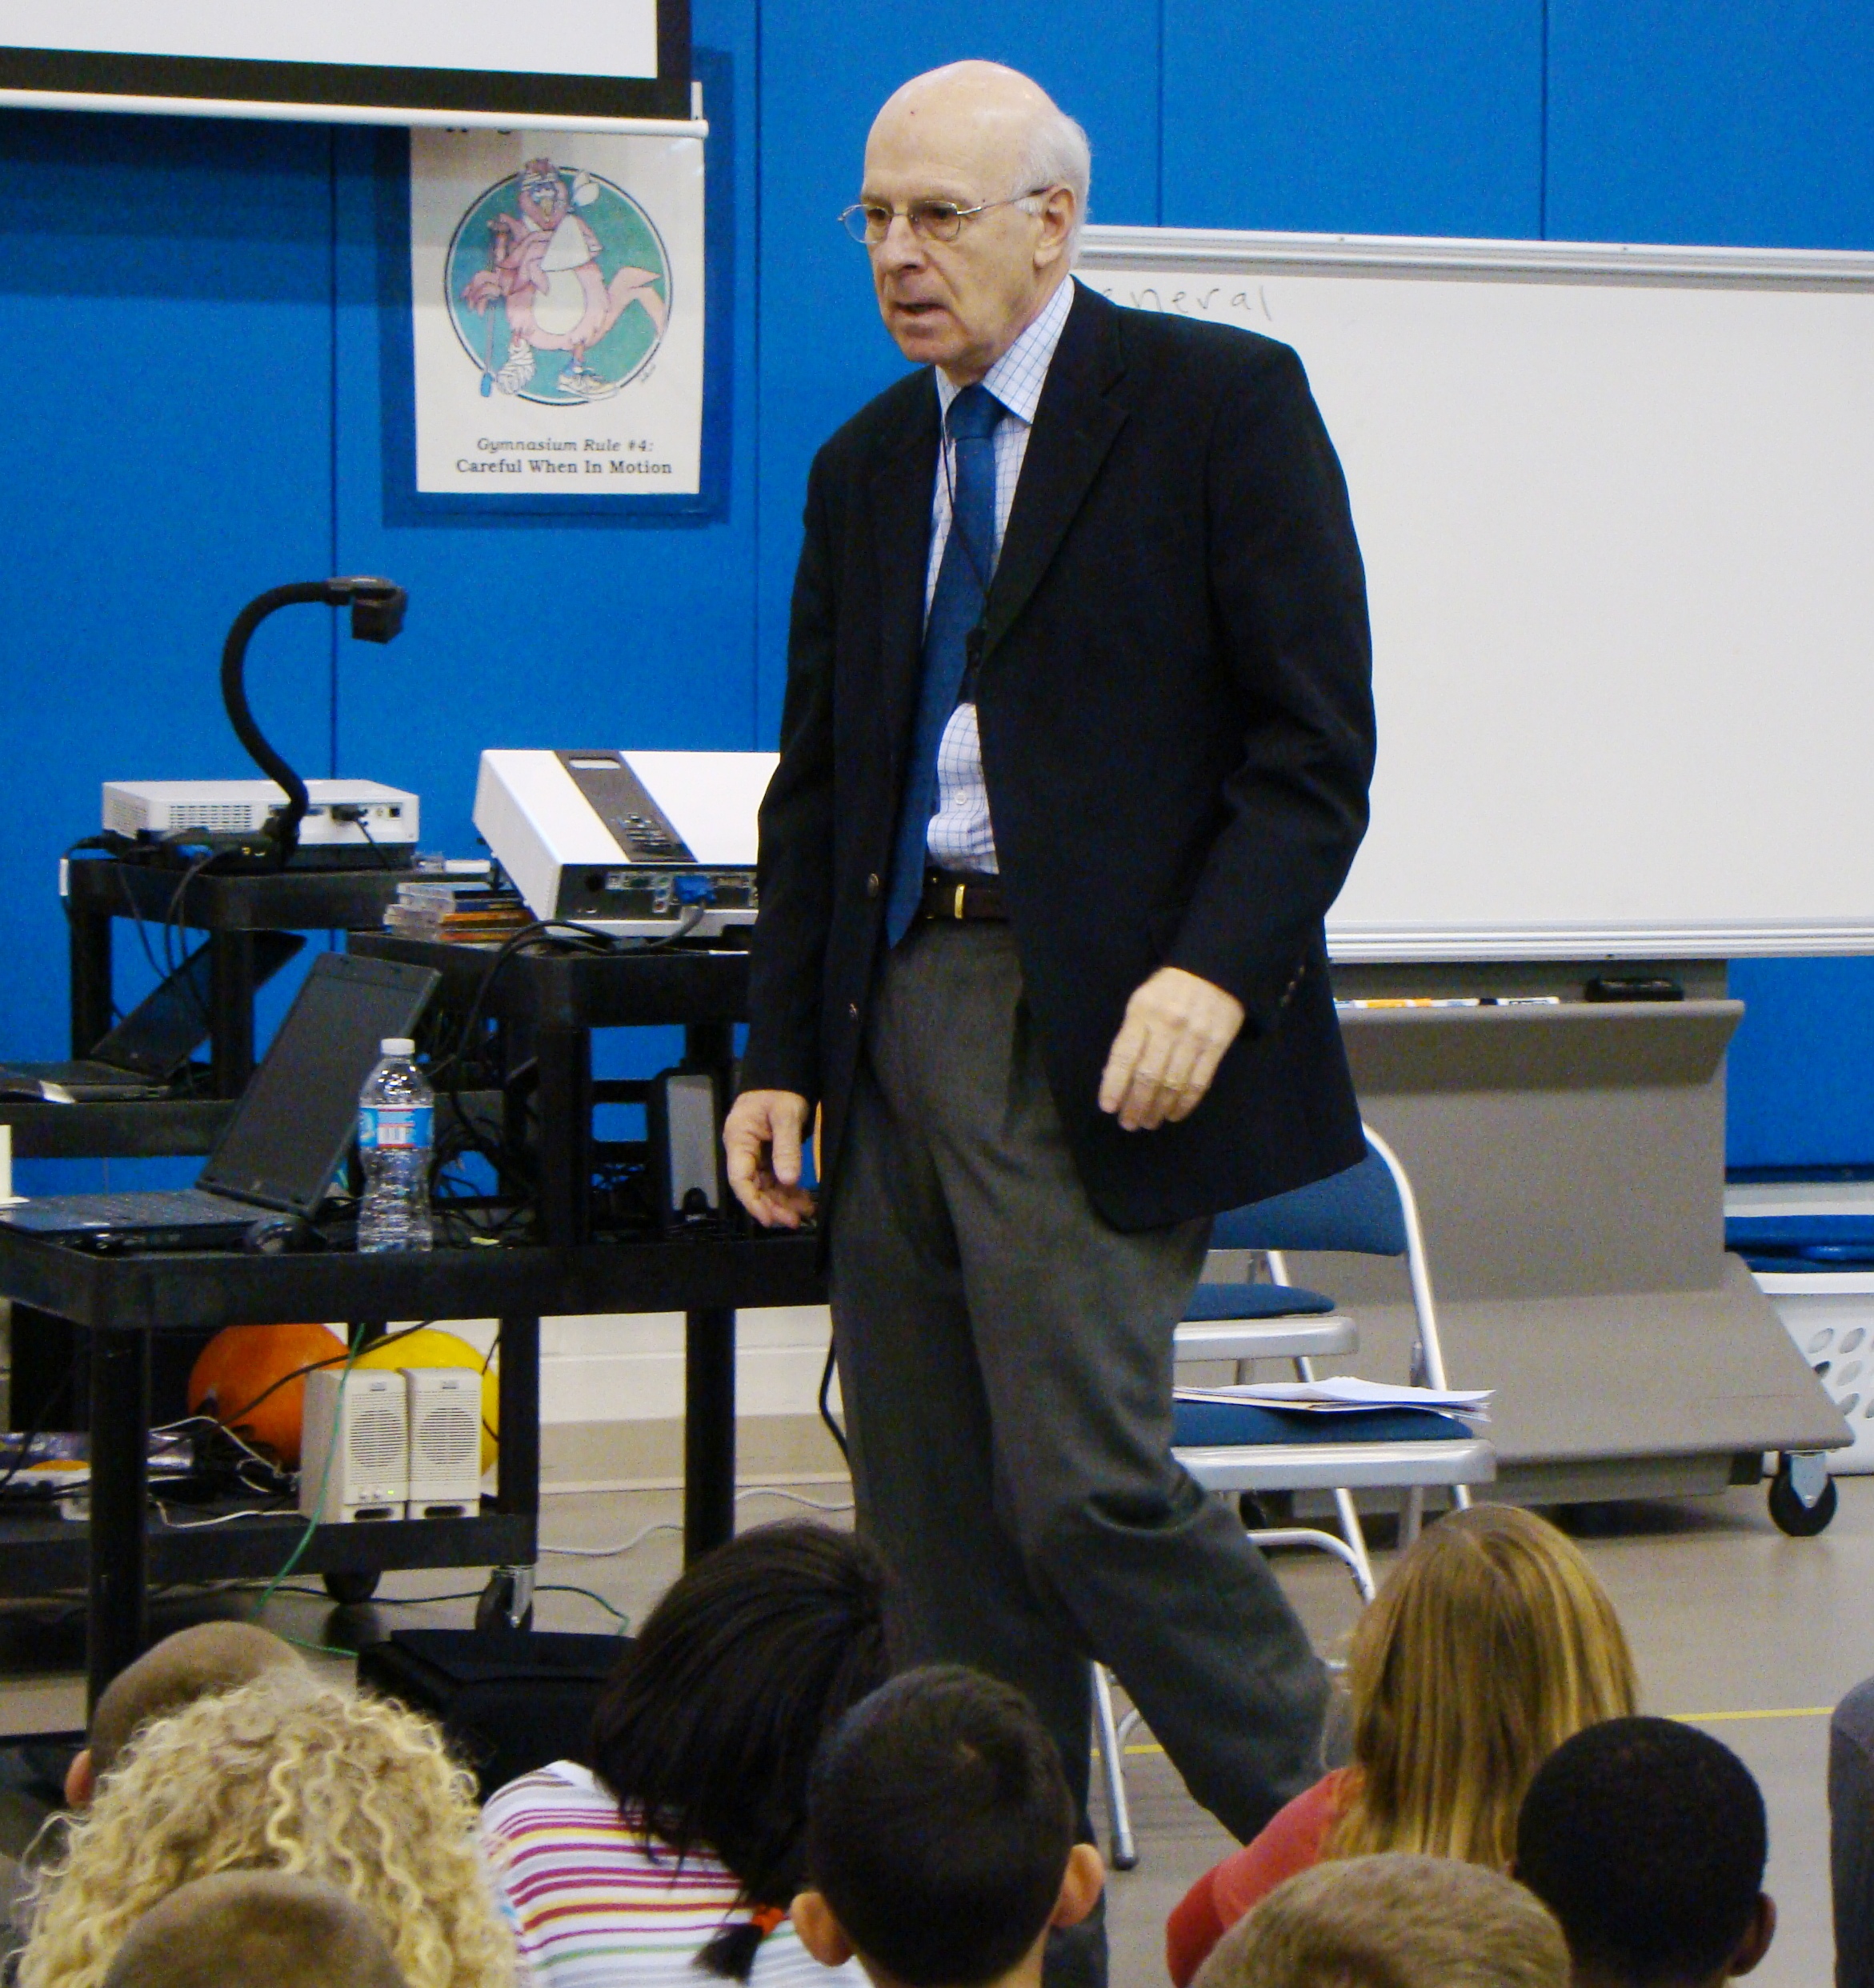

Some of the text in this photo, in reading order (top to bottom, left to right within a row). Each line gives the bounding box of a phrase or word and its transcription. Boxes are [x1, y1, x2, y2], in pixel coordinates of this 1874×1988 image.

[477, 437, 655, 454] Gymnasium Rule #4:
[456, 458, 672, 474] Careful When In Motion
